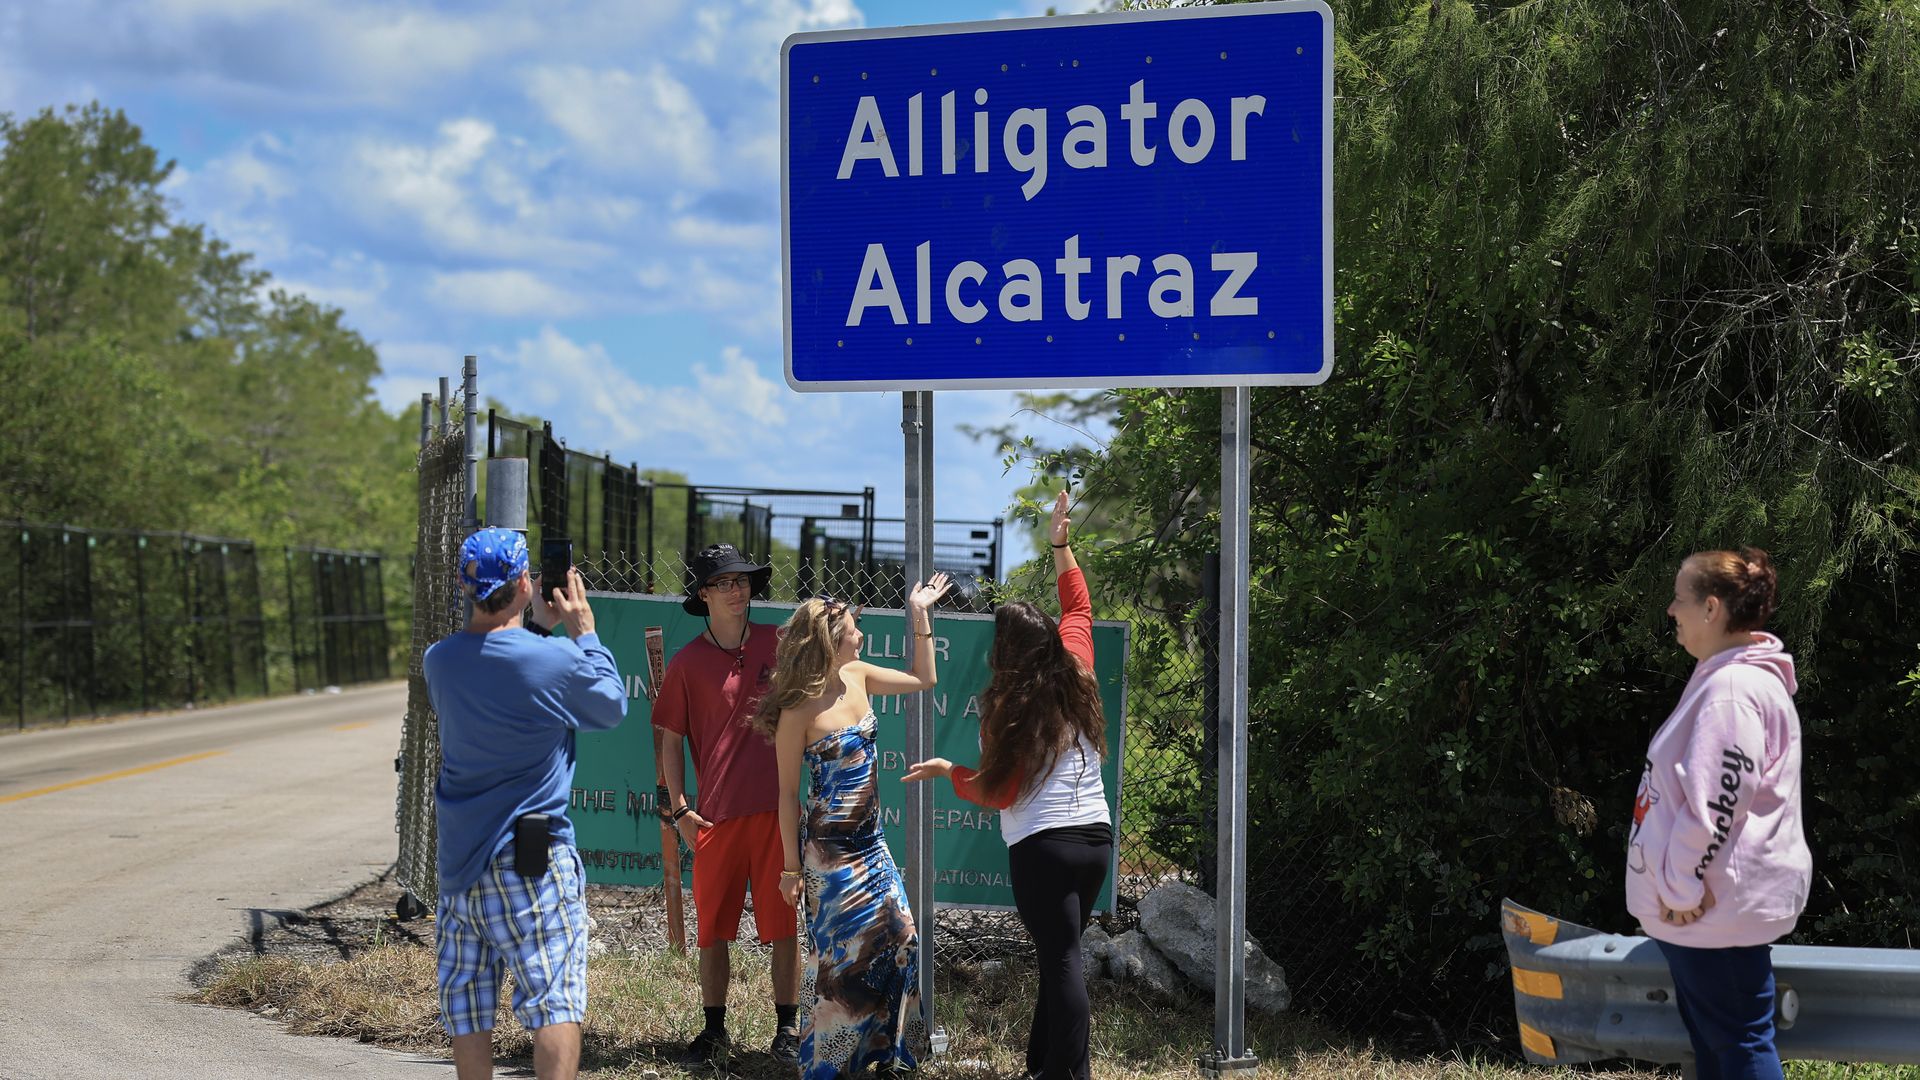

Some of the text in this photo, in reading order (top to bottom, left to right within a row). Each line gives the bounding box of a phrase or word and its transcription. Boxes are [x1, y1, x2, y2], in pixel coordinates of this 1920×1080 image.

[836, 78, 1267, 202] Alligator
[845, 233, 1259, 327] Alcatraz
[570, 788, 615, 811] THE
